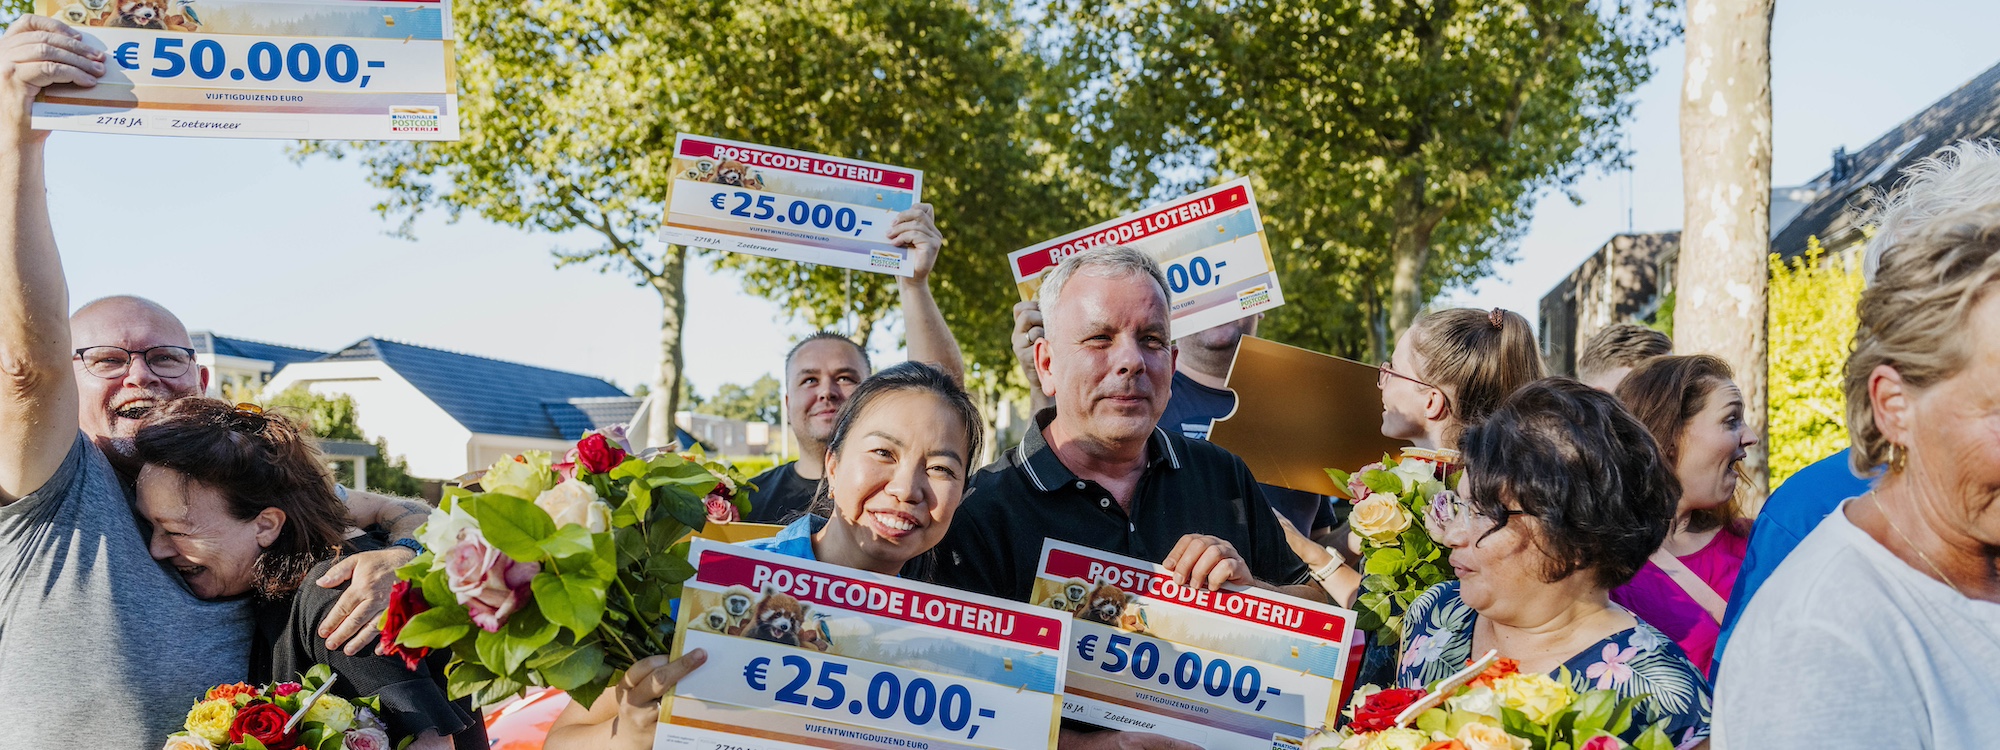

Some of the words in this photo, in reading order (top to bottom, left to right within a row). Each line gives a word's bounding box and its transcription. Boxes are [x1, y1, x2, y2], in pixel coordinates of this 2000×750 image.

[113, 42, 140, 70] €
[151, 38, 385, 88] 50.000,-
[206, 93, 278, 101] VIJFTIGDUIZEND
[97, 116, 126, 125] 2718
[127, 118, 143, 127] JA
[171, 119, 241, 130] Zoetermeer
[713, 146, 810, 171] POSTCODE
[813, 160, 883, 183] LOTERIJ
[710, 192, 725, 210] €
[730, 191, 872, 236] 25.000,-
[1049, 221, 1144, 264] POSTCODE
[1145, 197, 1217, 233] LOTERIJ
[737, 242, 779, 252] Zoetermeer
[749, 226, 814, 240] VIJFENTWINTIGDUIZEND
[1166, 256, 1227, 293] 00,-
[1180, 300, 1195, 309] EURO
[752, 564, 905, 615] POSTCODE
[909, 596, 1015, 636] LOTERIJ
[1088, 562, 1209, 607] POSTCODE
[1214, 591, 1304, 629] LOTERIJ
[1076, 634, 1099, 662] €
[1100, 633, 1281, 712] 50.000,-
[743, 656, 771, 691] €
[774, 655, 996, 740] 25.000,-
[1135, 692, 1190, 709] VIJFTIGDUIZEND
[1190, 705, 1209, 714] EURO
[805, 723, 905, 746] VIJFENTWINTIGDUIZEND
[906, 740, 929, 750] EURO
[1104, 711, 1156, 729] Zoetermeer
